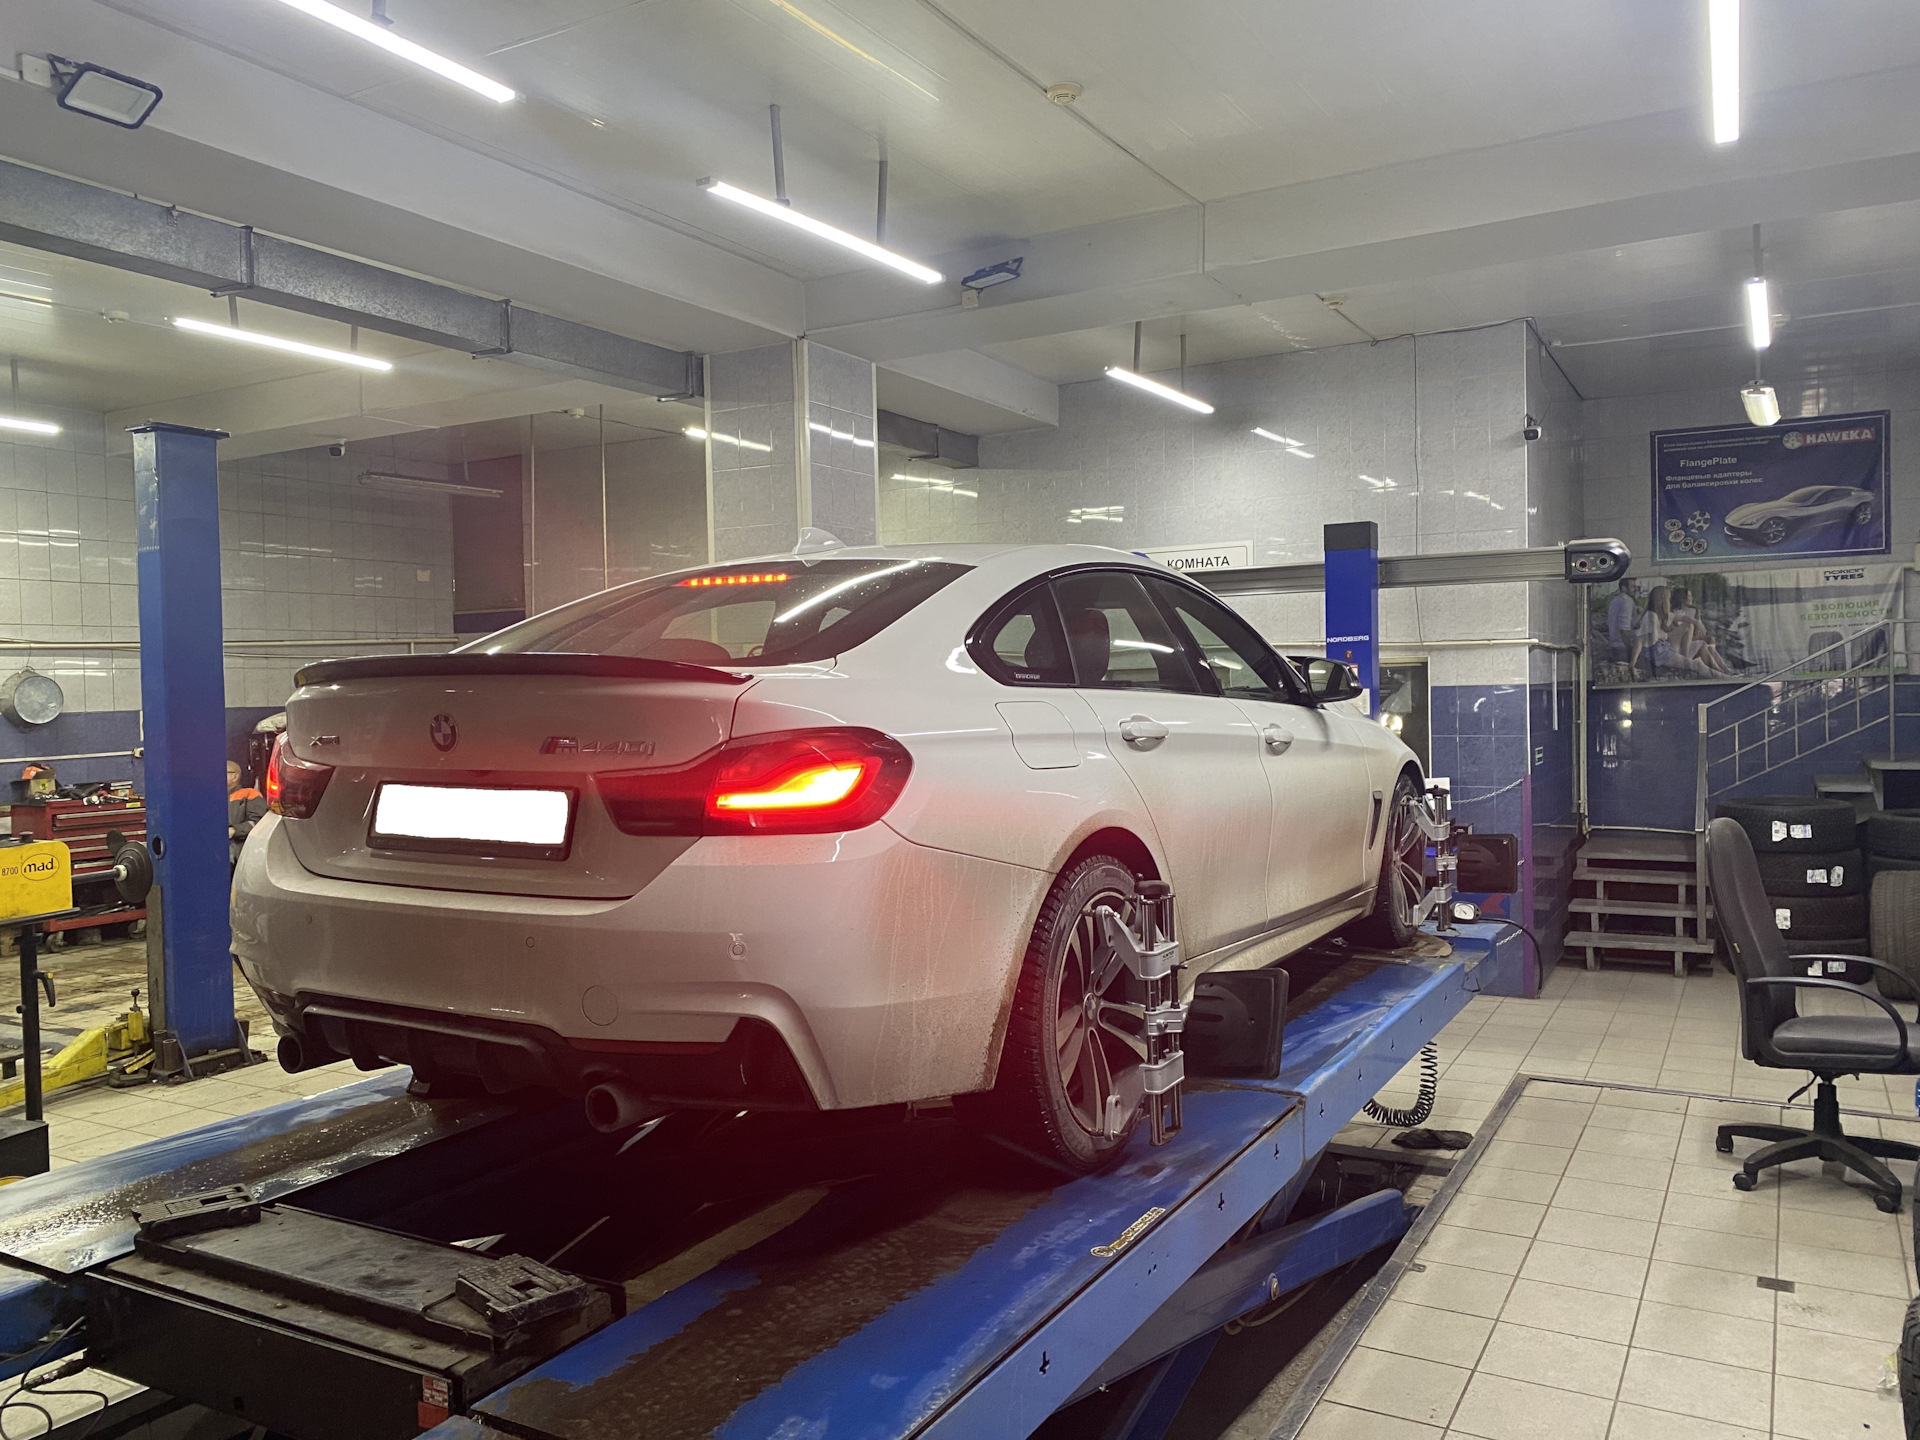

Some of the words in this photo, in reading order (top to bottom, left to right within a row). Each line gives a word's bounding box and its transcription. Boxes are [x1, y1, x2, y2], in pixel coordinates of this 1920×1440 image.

[1806, 429, 1872, 444] HAWEKA
[1679, 456, 1738, 468] FlangePlate
[1665, 473, 1711, 482] Фланцевые
[1713, 470, 1752, 479] адаптеры
[1665, 483, 1681, 491] для
[1682, 479, 1738, 489] балансировки
[1740, 477, 1763, 485] колес
[1167, 556, 1230, 570] КОМНАТА
[1824, 573, 1865, 581] TYRES
[1799, 607, 1893, 621] БЕЗОПАСНОСТИ
[1326, 635, 1370, 643] NORDBERG
[1, 866, 19, 876] 8700
[23, 858, 54, 873] mad
